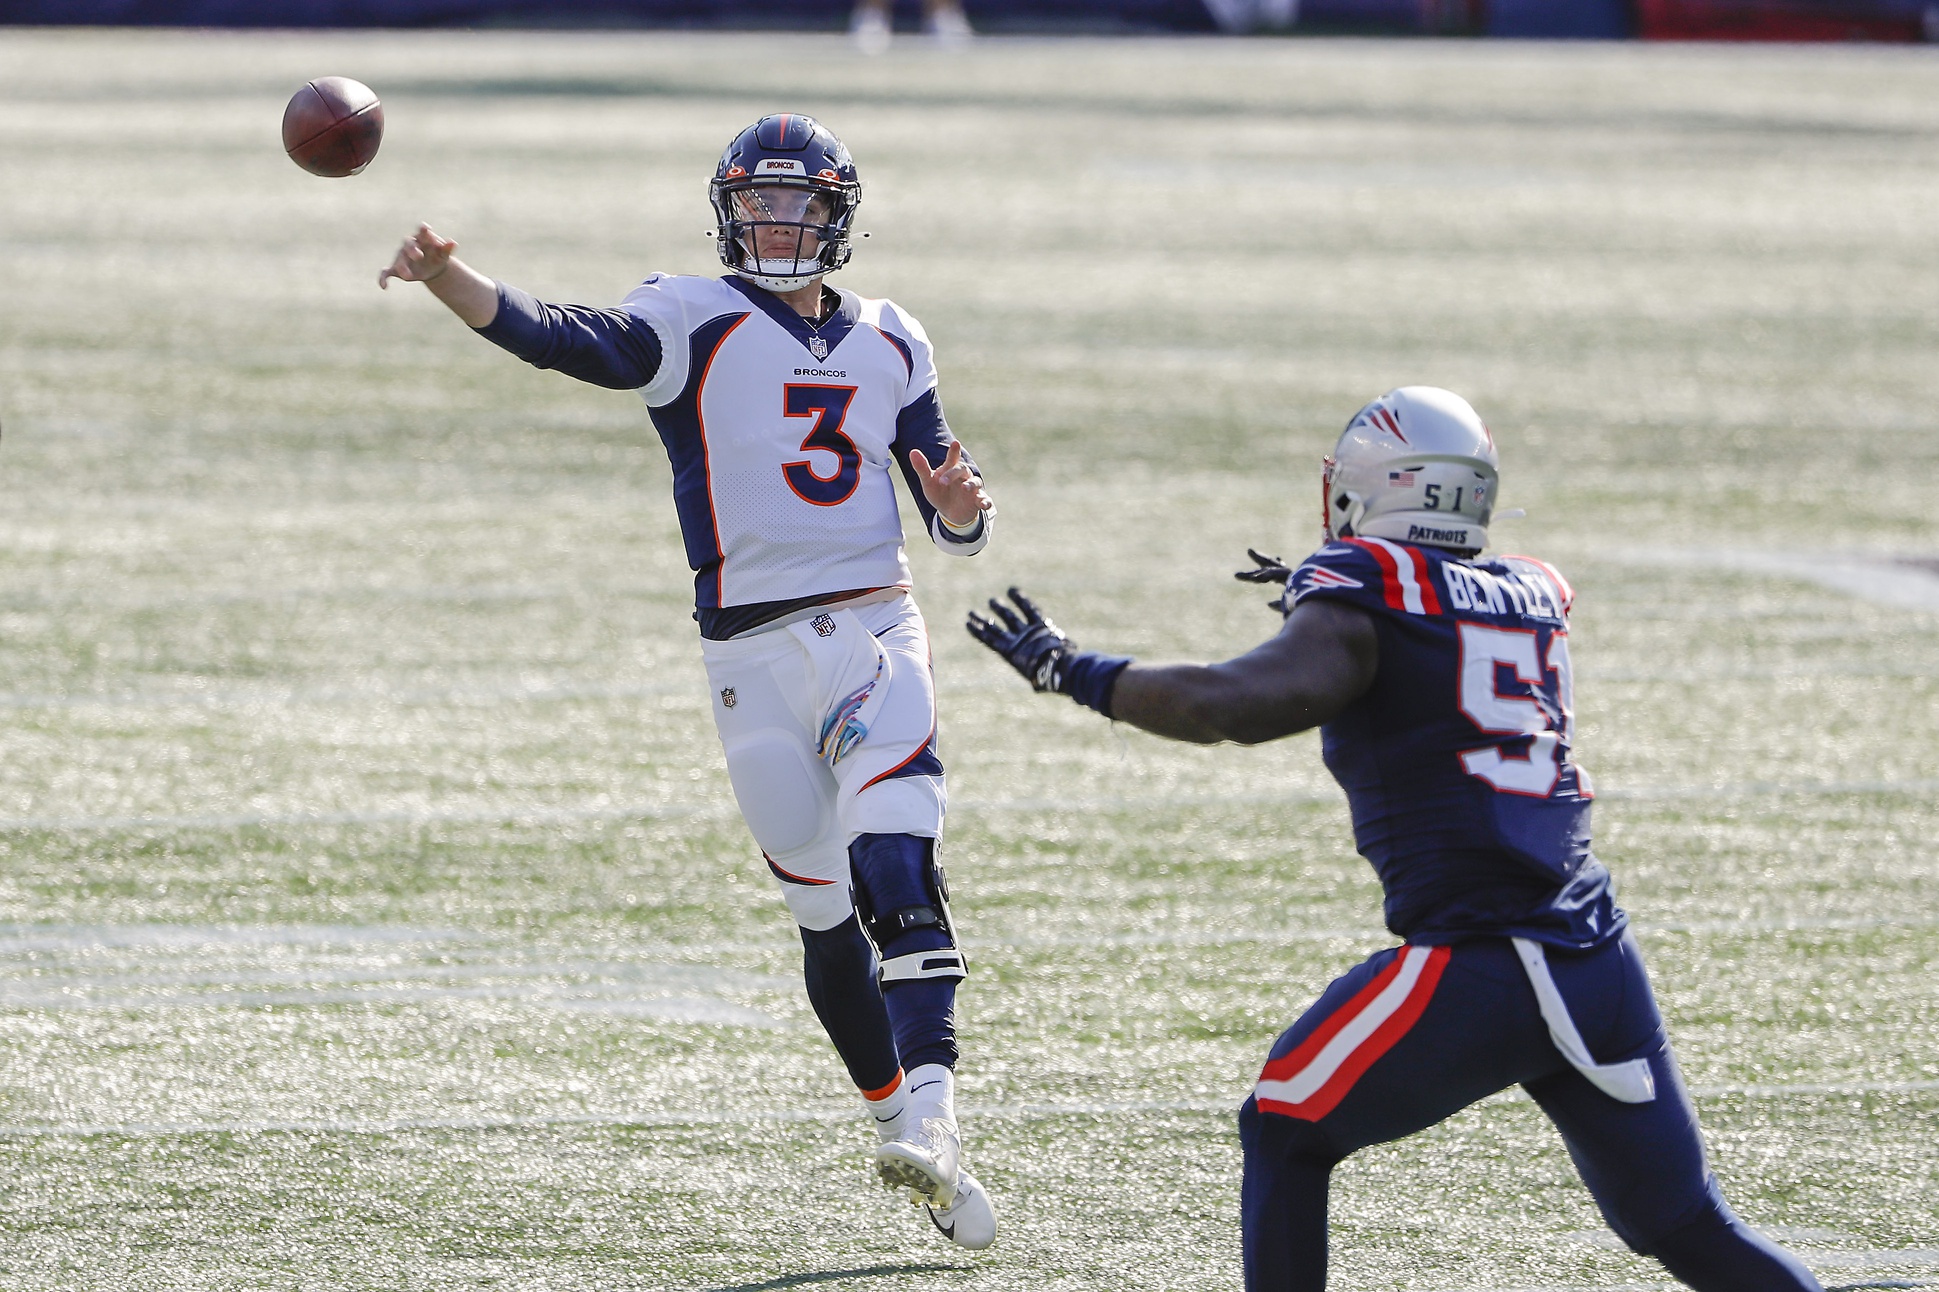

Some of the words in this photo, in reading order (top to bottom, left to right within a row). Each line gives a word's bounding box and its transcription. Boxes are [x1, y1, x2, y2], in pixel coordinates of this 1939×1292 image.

[794, 368, 847, 378] BRONCOS
[781, 383, 862, 507] 3
[1424, 484, 1463, 511] 51
[1408, 524, 1468, 544] PATRIOTS
